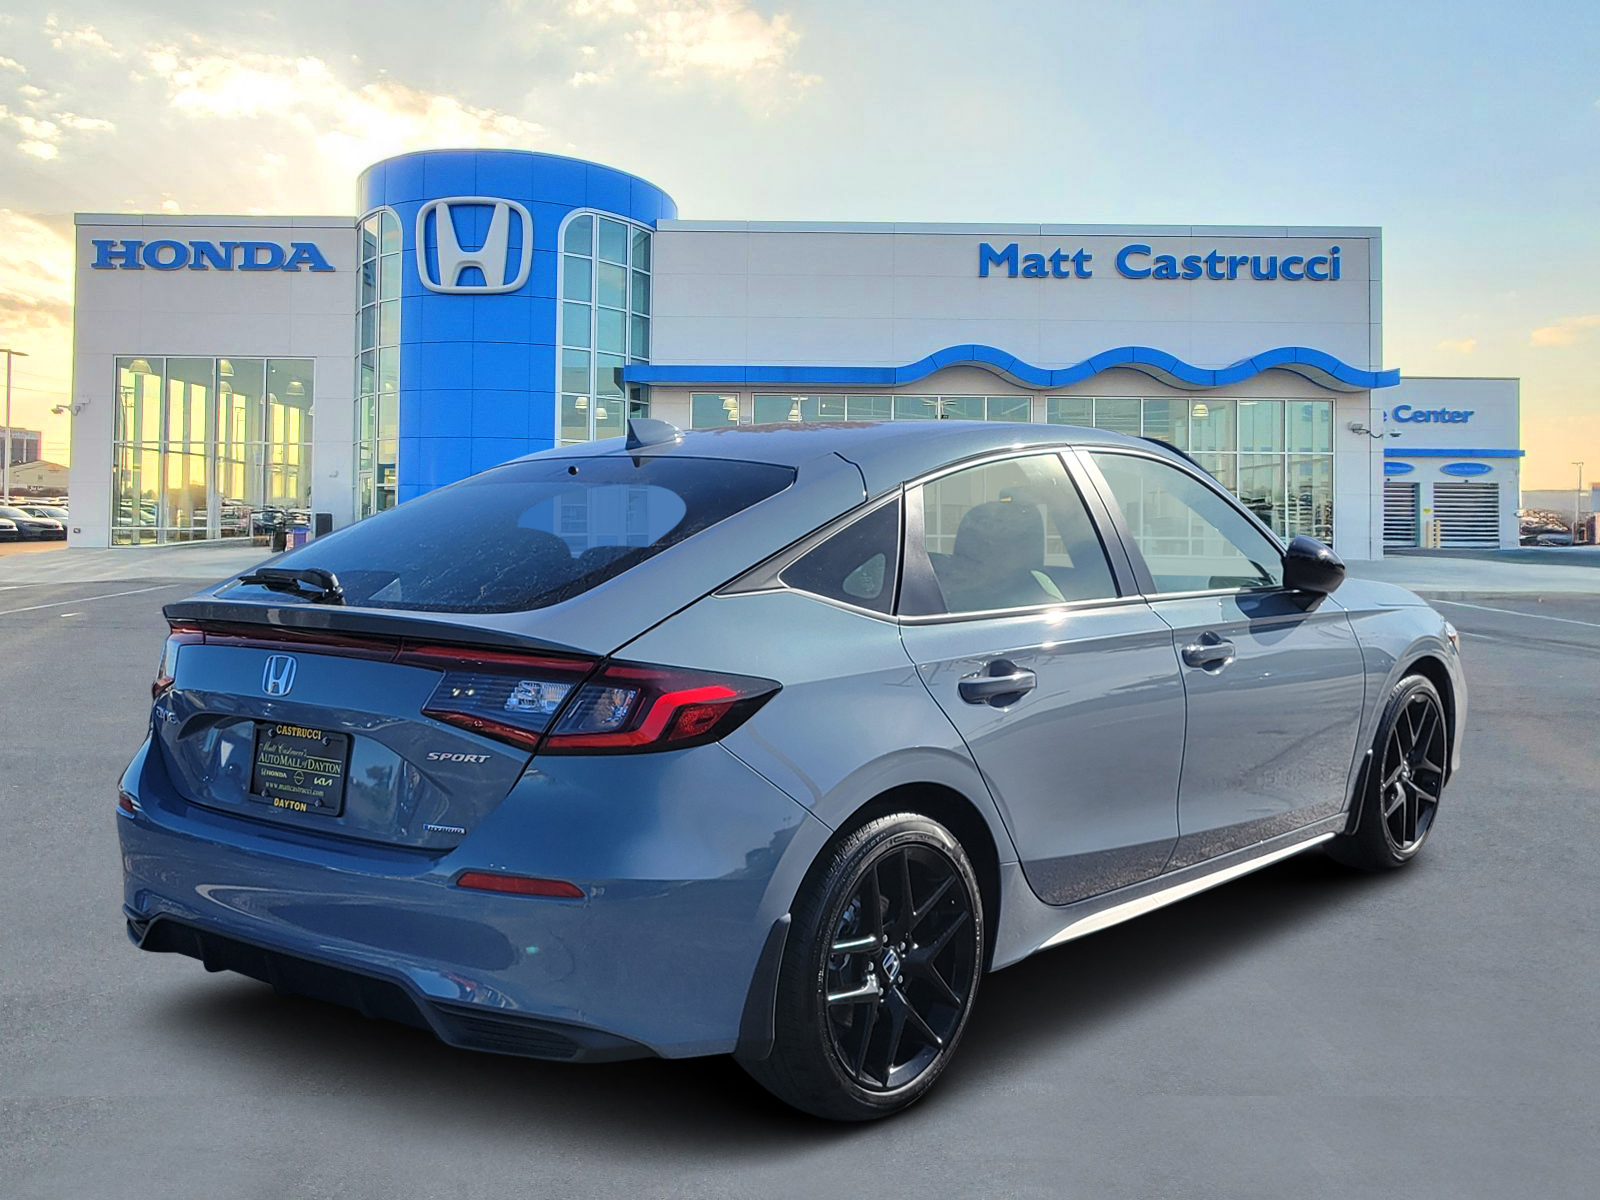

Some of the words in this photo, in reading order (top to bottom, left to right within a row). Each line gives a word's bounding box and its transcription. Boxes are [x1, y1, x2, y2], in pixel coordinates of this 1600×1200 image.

[90, 238, 336, 273] HONDA
[978, 242, 1094, 280] Matt
[1114, 243, 1343, 281] Castrucci
[1391, 404, 1475, 424] Center
[276, 724, 322, 740] CASTRUCCI
[426, 752, 492, 763] SPORT
[307, 759, 342, 774] DAYTON
[273, 797, 307, 812] DAYTON
